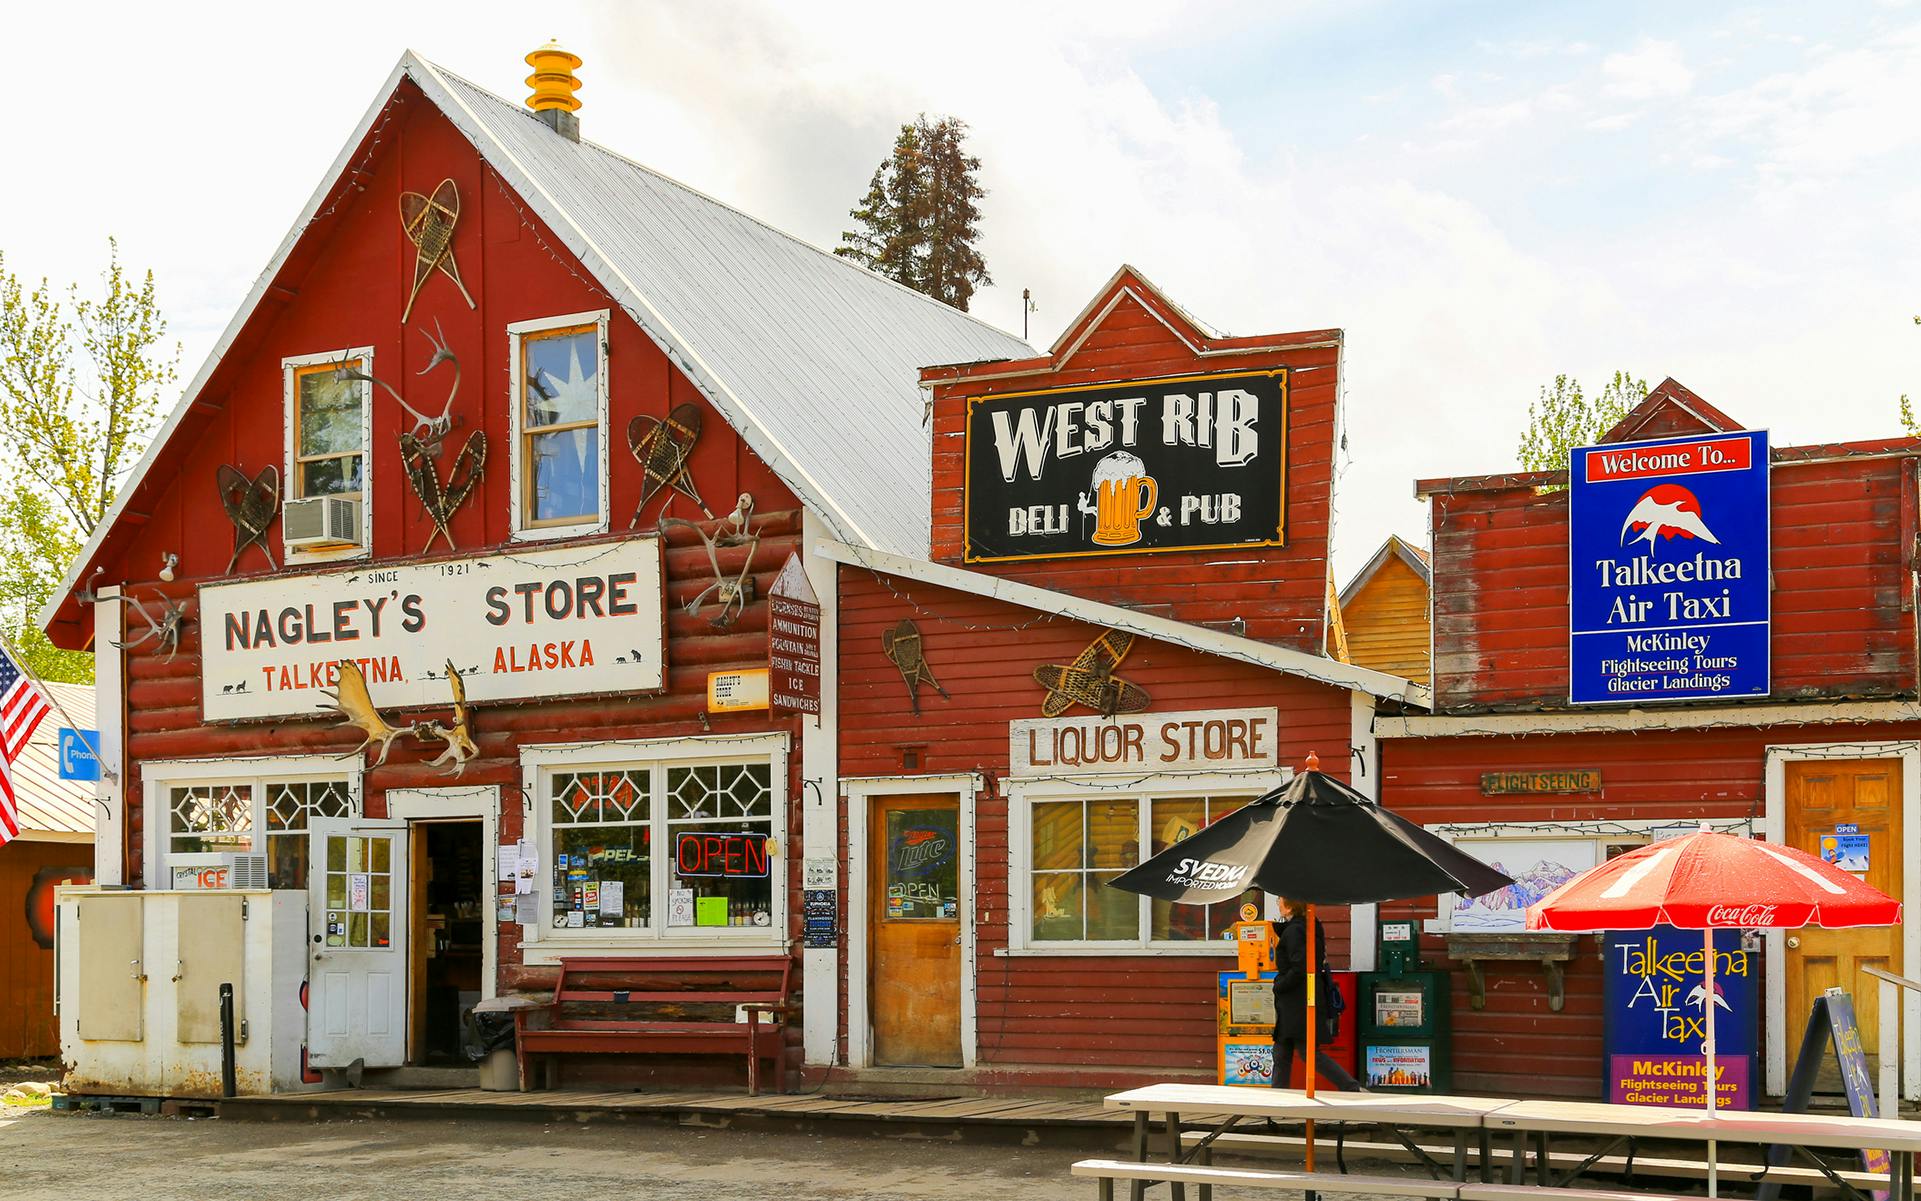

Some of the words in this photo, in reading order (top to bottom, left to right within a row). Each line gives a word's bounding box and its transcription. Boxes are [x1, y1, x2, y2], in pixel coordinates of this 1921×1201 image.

[991, 397, 1147, 483] WEST
[1160, 389, 1260, 468] RIB
[1601, 452, 1691, 475] Welcome
[1698, 445, 1736, 466] To...
[1008, 504, 1070, 537] DELI
[1156, 506, 1173, 527] &
[1180, 492, 1241, 526] PUB
[368, 570, 398, 584] SINCE
[441, 563, 470, 577] 1921
[1596, 552, 1741, 588] Talkeetna
[224, 589, 426, 652] NAGLEY'S
[485, 572, 638, 627] STORE
[1606, 594, 1653, 624] Air
[1663, 588, 1731, 621] Taxi
[772, 618, 817, 639] AMMUNITION
[1626, 632, 1711, 655] McKinley
[262, 655, 409, 692] TALKETNA,
[492, 639, 595, 674] ALASKA
[794, 660, 819, 676] TACKLE
[1601, 658, 1689, 677] Flightseeing
[1694, 654, 1738, 669] Tours
[788, 677, 804, 691] ICE
[1608, 675, 1659, 693] Glacier
[1663, 673, 1731, 691] Landings
[773, 693, 819, 711] SANDWICHES
[1029, 724, 1145, 767] LIQUOR
[1159, 718, 1267, 763] STORE
[679, 835, 767, 873] OPEN
[197, 869, 228, 888] ICE
[1173, 858, 1248, 881] SVEDKA
[898, 882, 940, 899] OPEN
[1166, 874, 1216, 890] IMPORTED
[1627, 975, 1680, 1008] Air
[1654, 1007, 1708, 1043] Tax
[1621, 1079, 1697, 1093] Flightseeing
[1702, 1081, 1737, 1092] Turs
[1626, 1093, 1669, 1103] Glacier
[1674, 1094, 1732, 1107] Landigs
